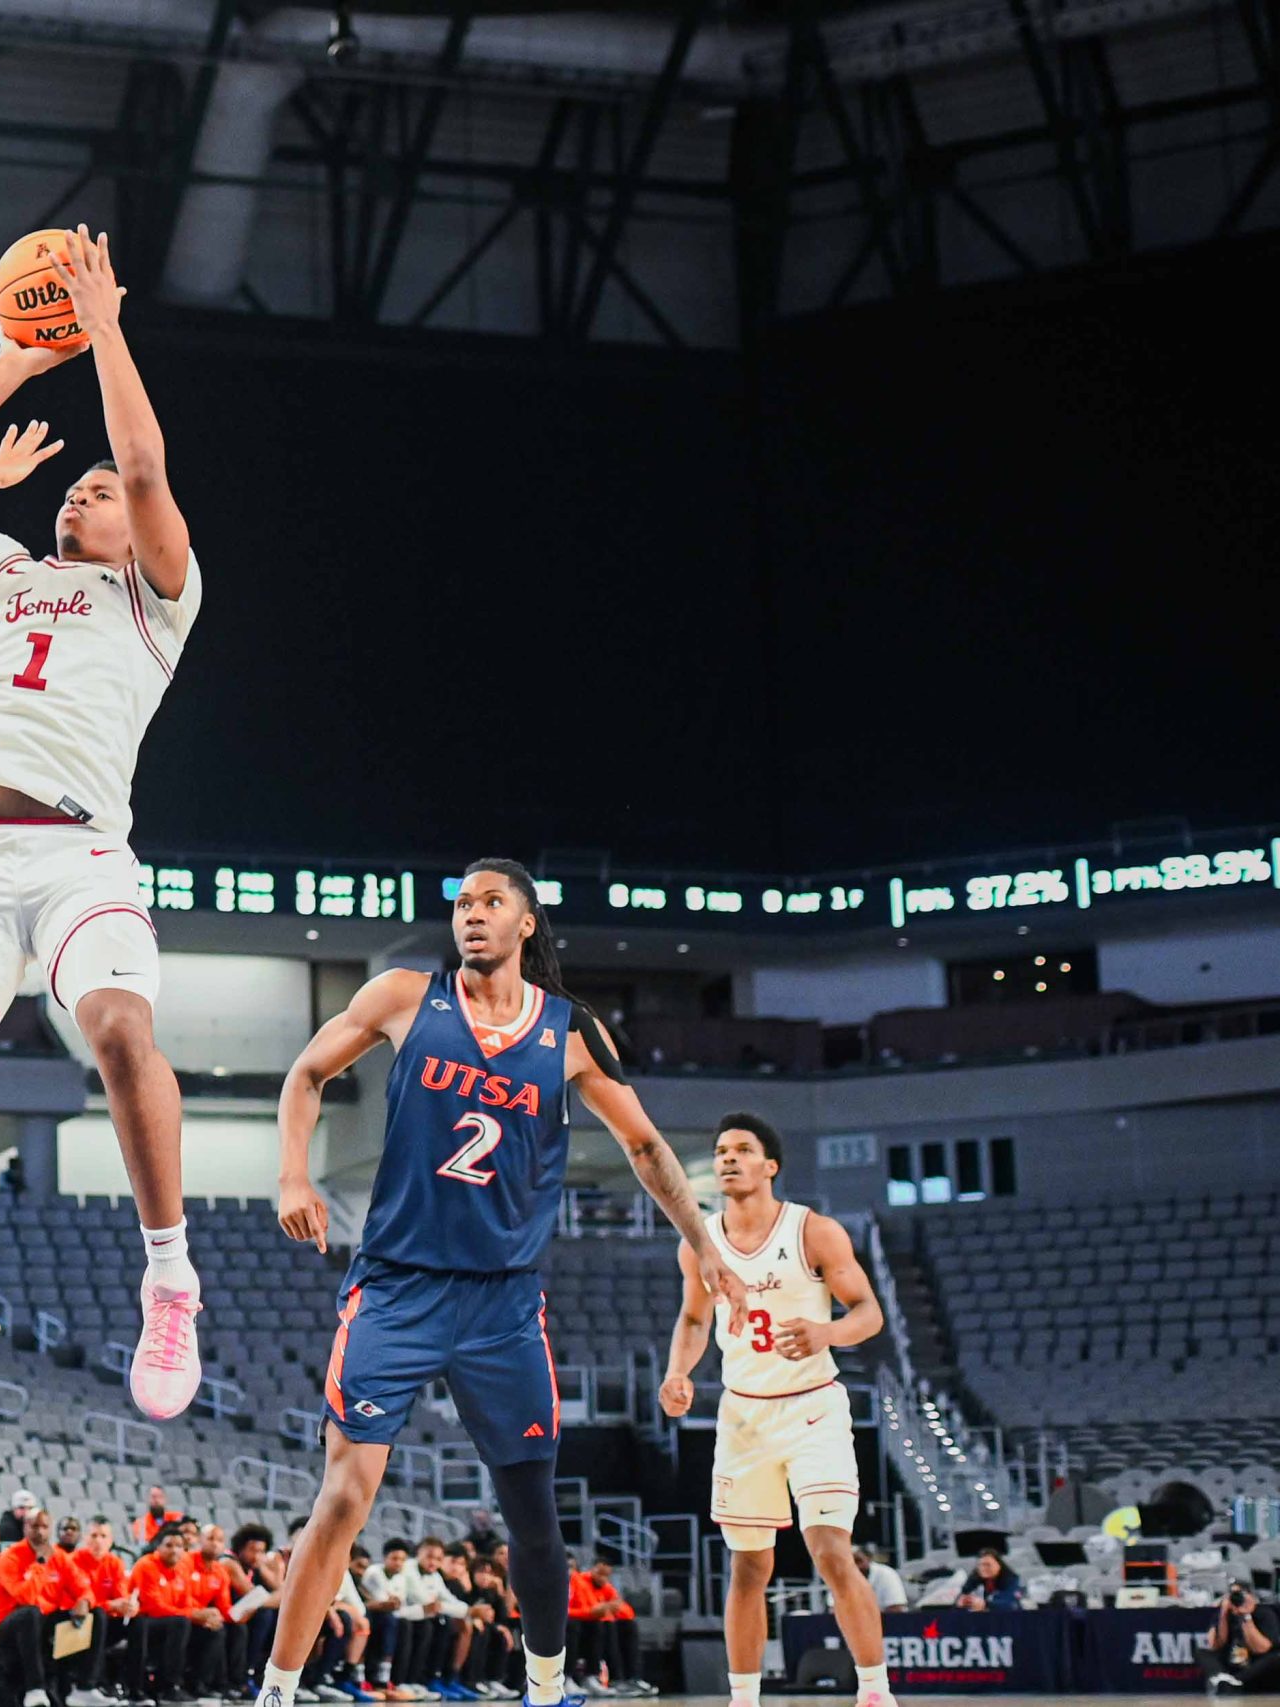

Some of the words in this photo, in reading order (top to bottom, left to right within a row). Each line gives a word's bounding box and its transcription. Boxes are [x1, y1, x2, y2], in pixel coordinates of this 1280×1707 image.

[13, 281, 70, 311] Wils
[35, 322, 83, 341] NCA
[6, 587, 93, 624] Temple
[12, 632, 53, 691] 1
[421, 1056, 540, 1116] UTSA
[436, 1111, 503, 1186] 2
[748, 1309, 775, 1352] 3
